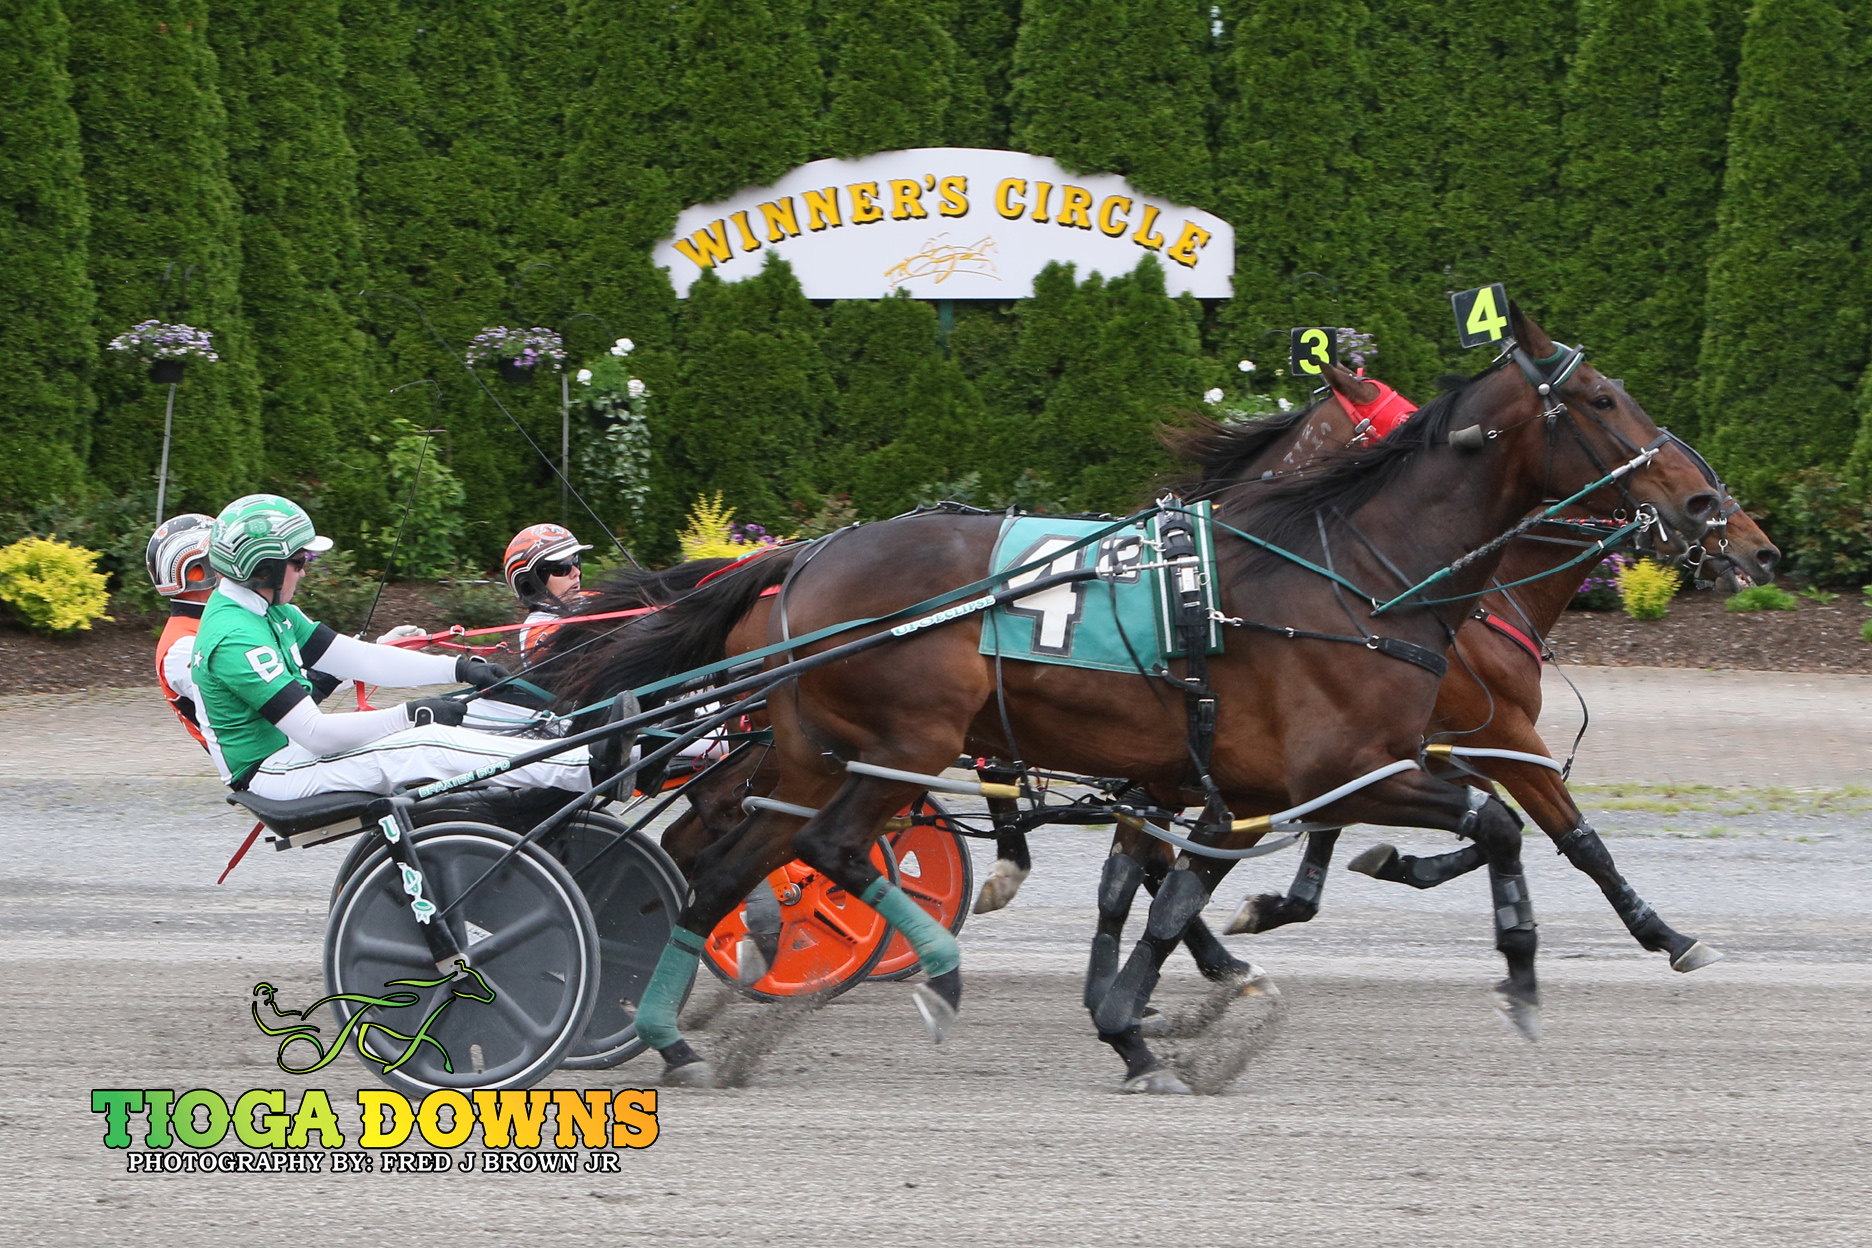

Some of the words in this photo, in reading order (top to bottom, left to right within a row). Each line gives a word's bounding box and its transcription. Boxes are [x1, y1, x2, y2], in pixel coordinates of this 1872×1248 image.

[673, 174, 970, 269] WINNER'S
[995, 177, 1211, 268] CIRCLE
[1466, 286, 1508, 341] 4
[1299, 328, 1330, 375] 3
[1005, 537, 1083, 653] 4
[244, 645, 285, 684] B
